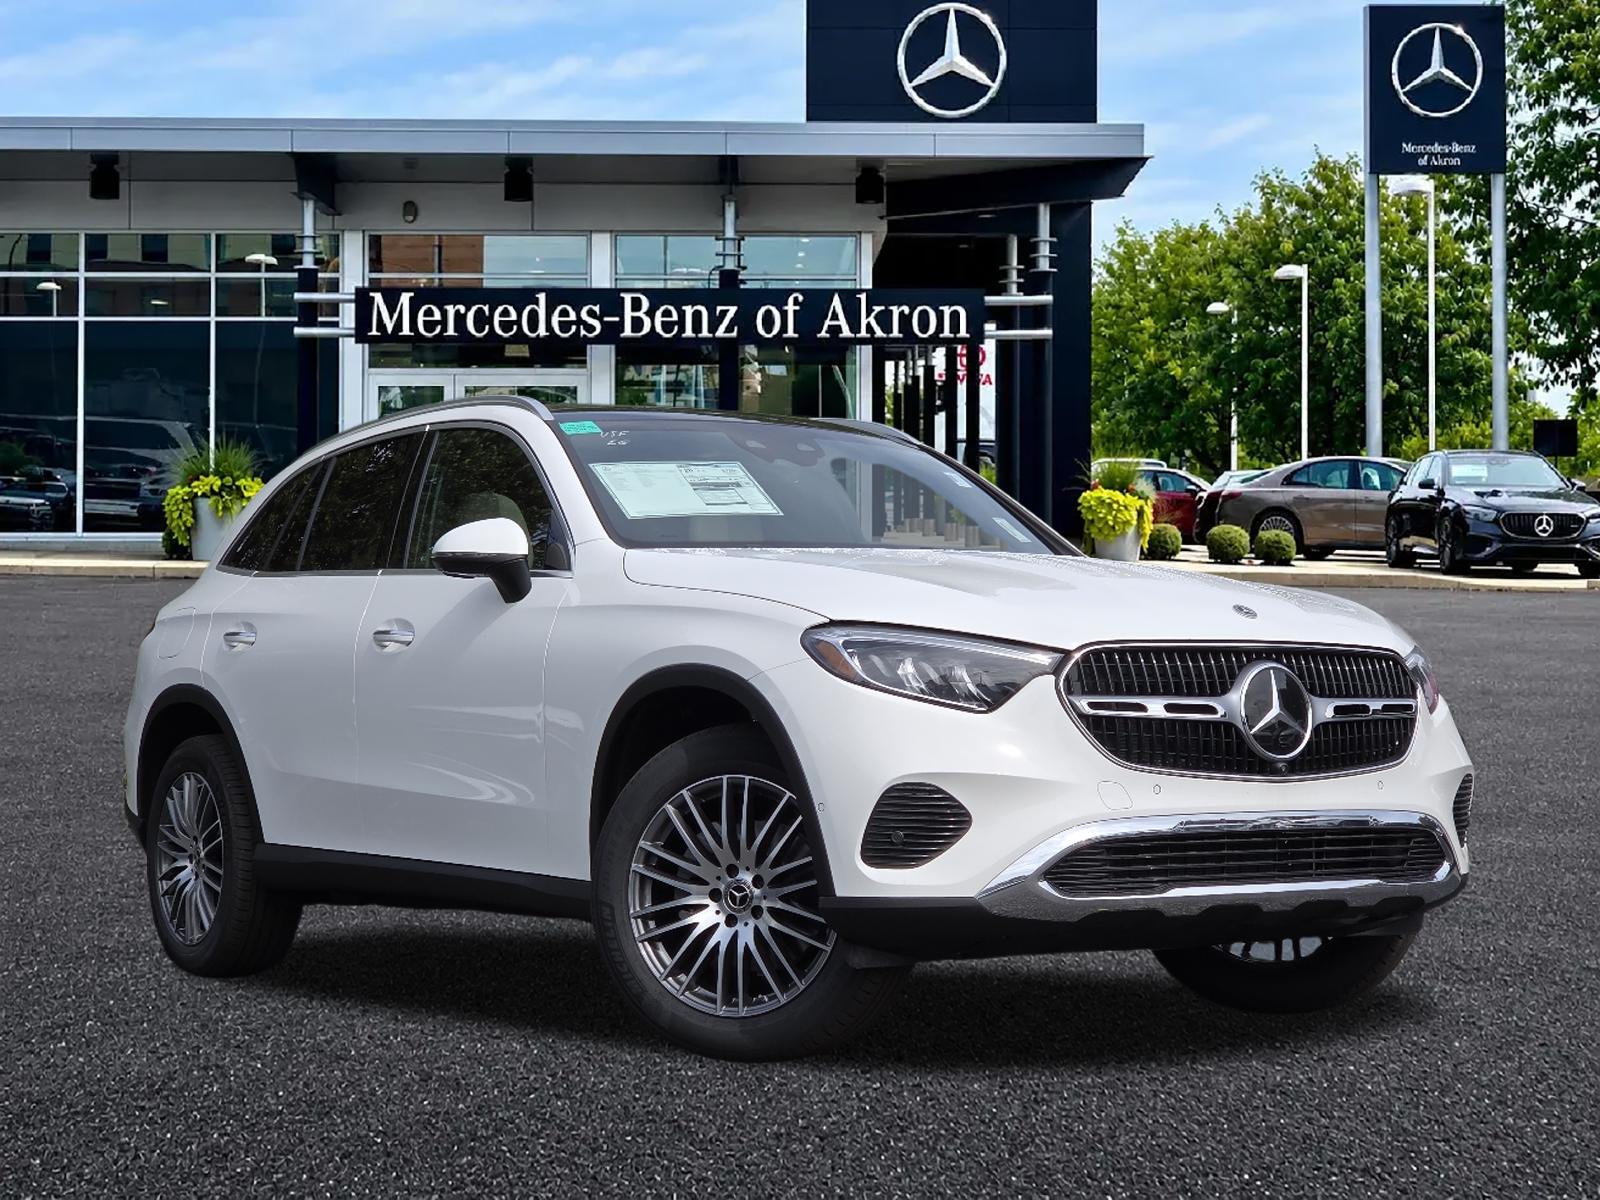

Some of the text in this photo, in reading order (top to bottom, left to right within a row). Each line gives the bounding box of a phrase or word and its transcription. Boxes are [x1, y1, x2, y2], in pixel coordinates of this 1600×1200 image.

[1401, 141, 1476, 153] Mercedes-Benz
[1418, 154, 1461, 166] of Akron
[367, 291, 970, 338] Mercedes-Benz of Akron
